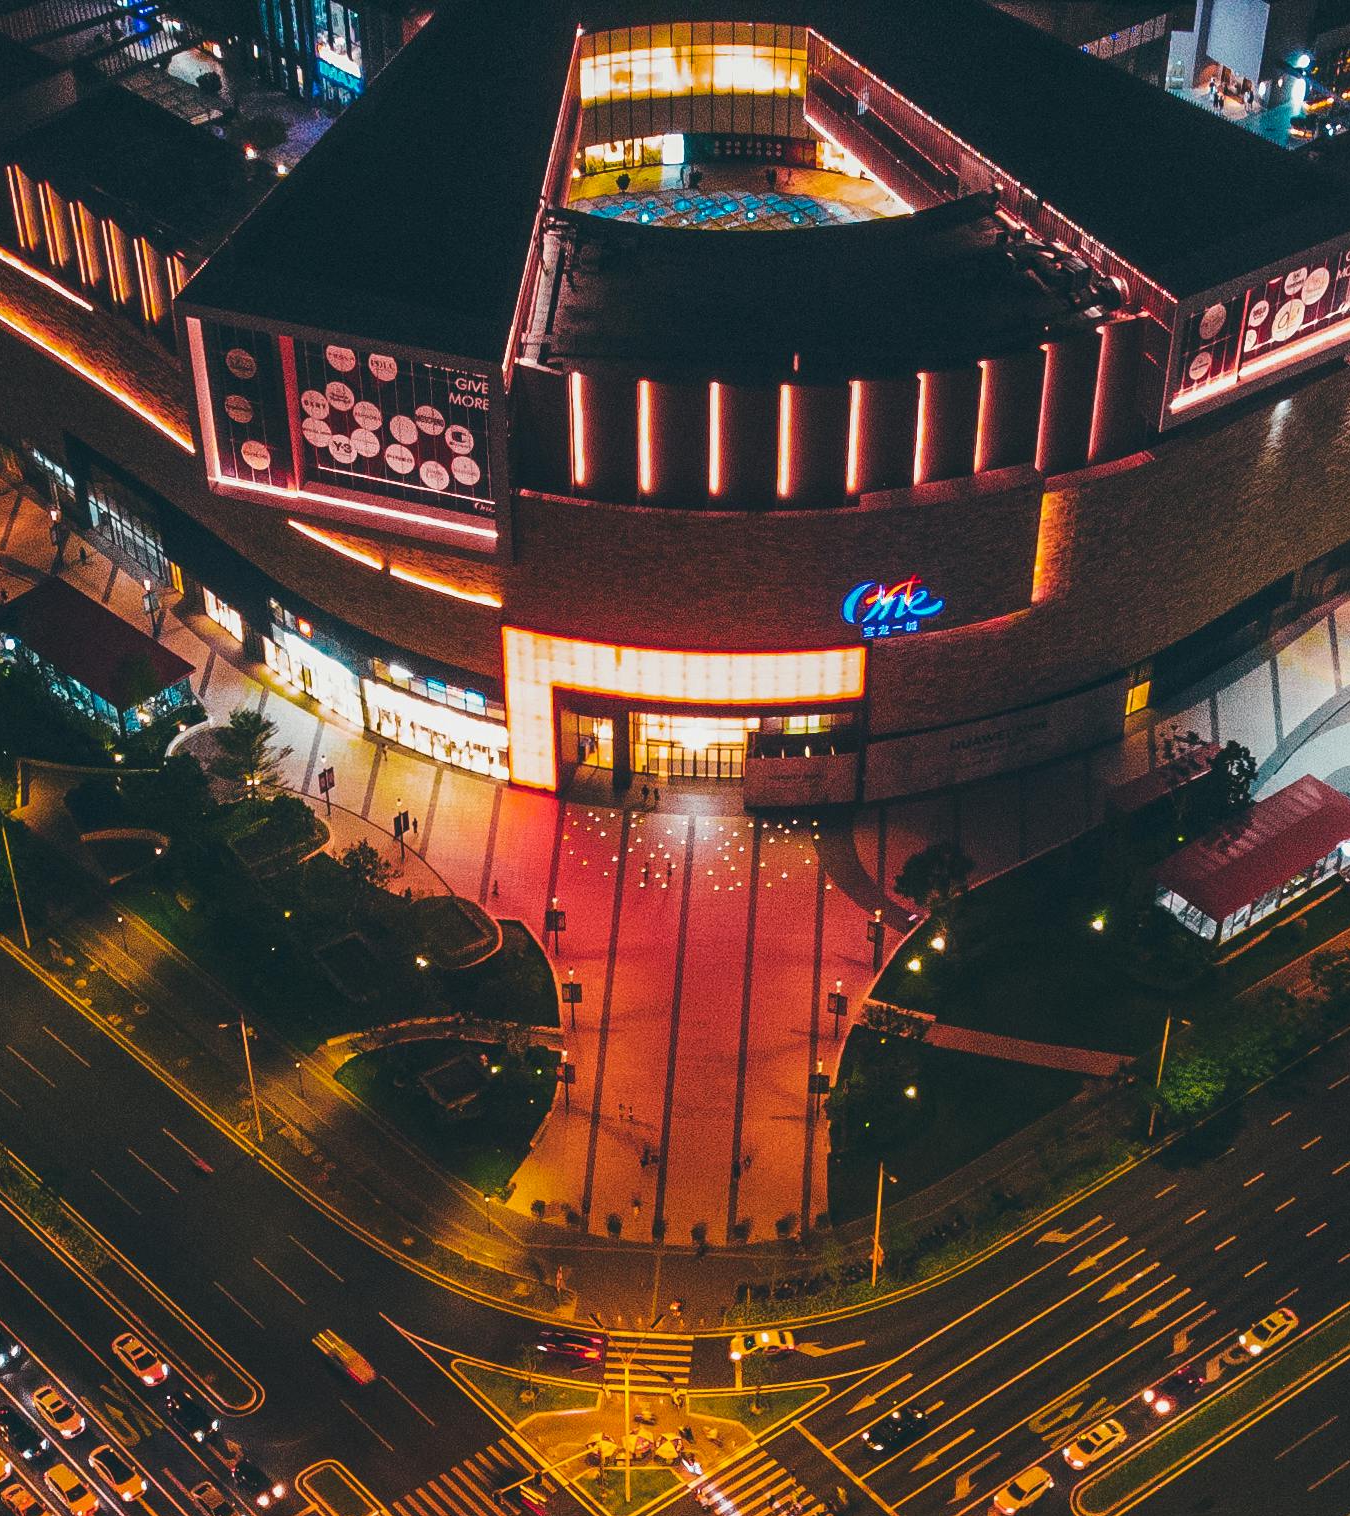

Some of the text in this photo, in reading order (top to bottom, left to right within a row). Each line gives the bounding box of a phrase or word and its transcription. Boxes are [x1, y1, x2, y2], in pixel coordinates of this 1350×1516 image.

[455, 377, 489, 395] GIVE
[449, 392, 490, 411] MORE
[333, 440, 353, 454] Y-3
